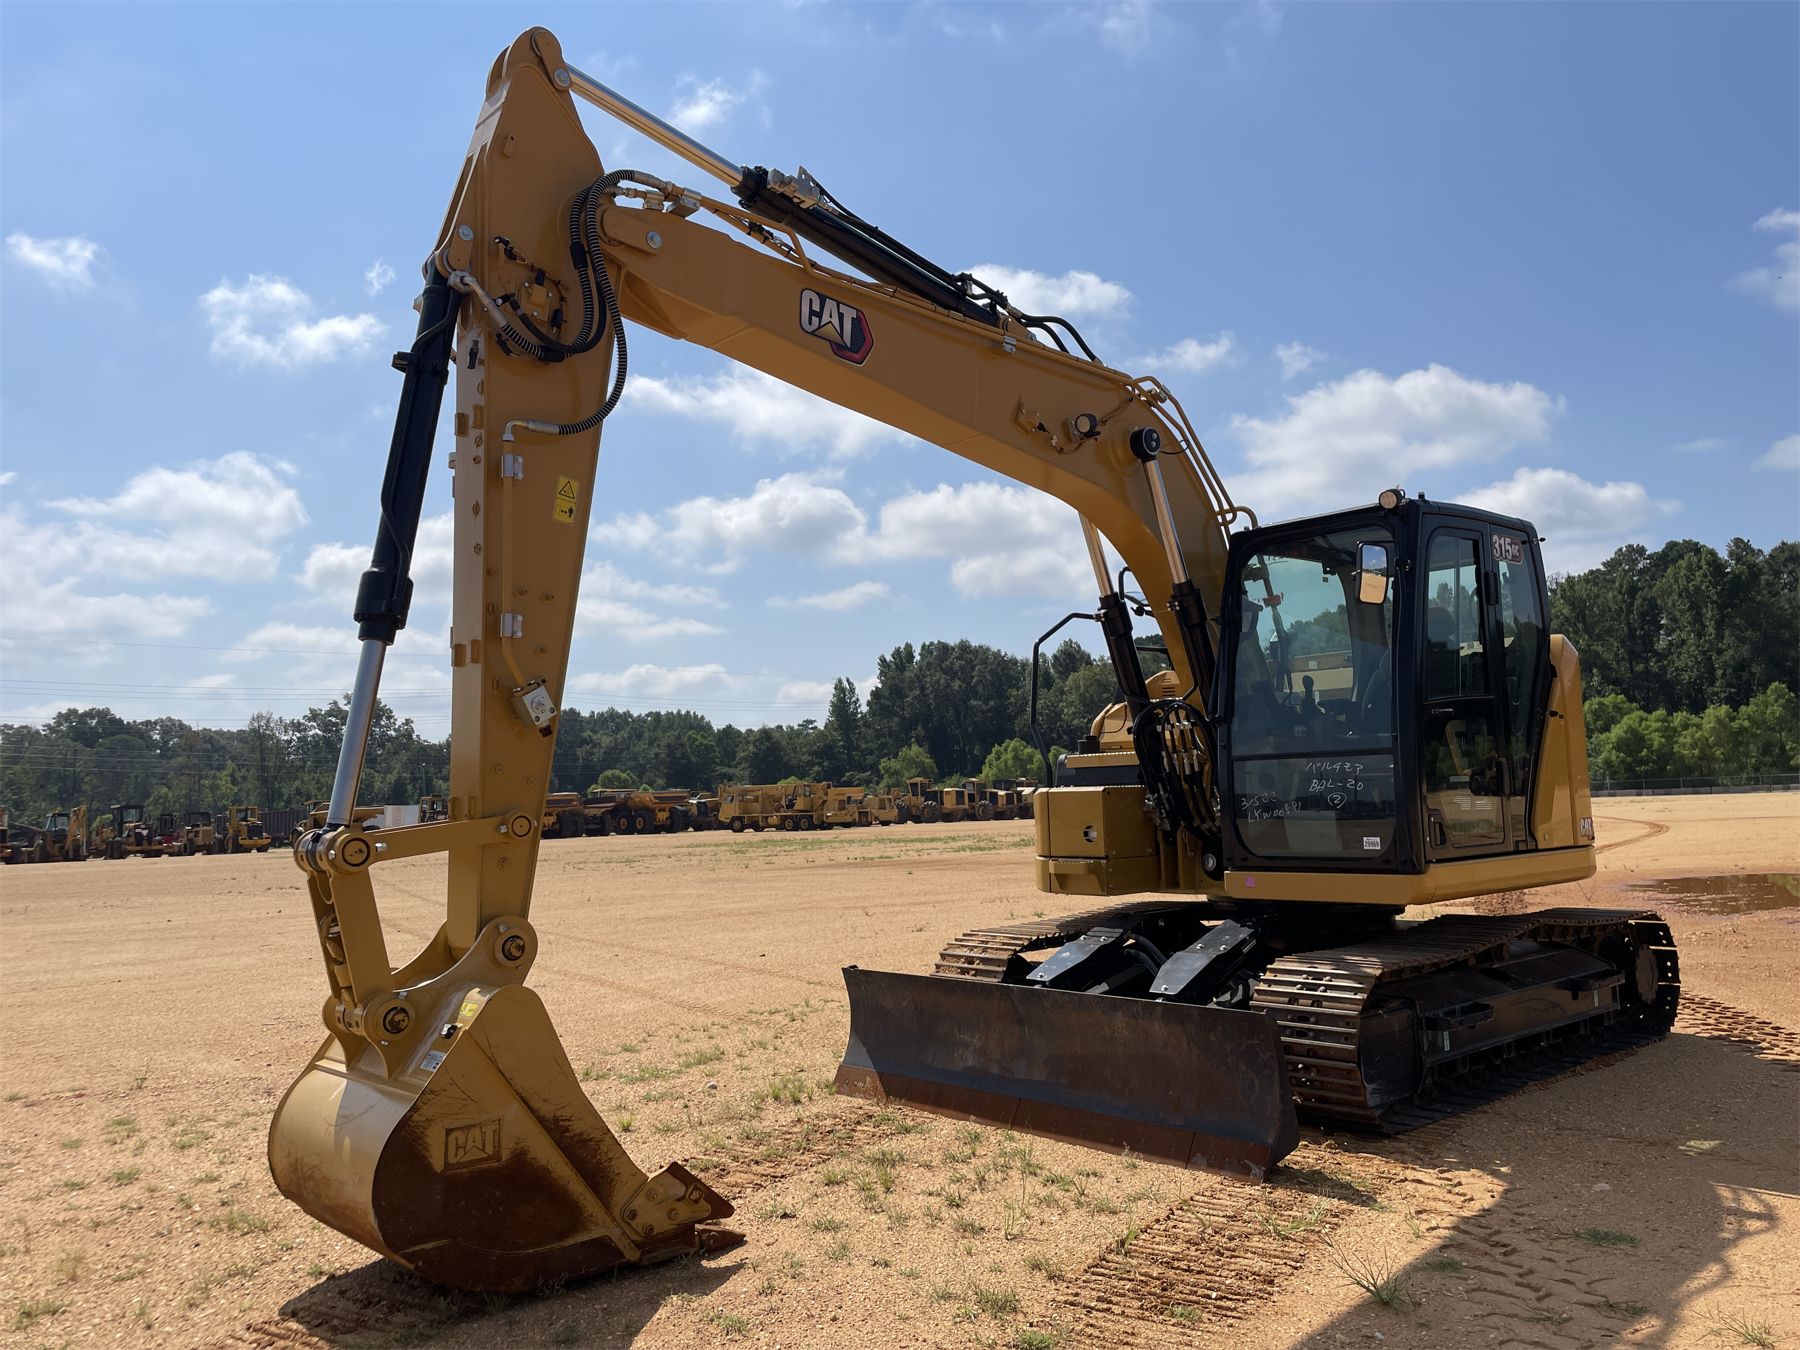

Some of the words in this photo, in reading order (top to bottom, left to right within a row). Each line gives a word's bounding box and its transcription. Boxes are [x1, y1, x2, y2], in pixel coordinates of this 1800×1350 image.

[801, 289, 857, 348] CAT
[1492, 534, 1512, 560] 315
[1309, 778, 1364, 793] BAL-20
[448, 1122, 496, 1163] CAT
